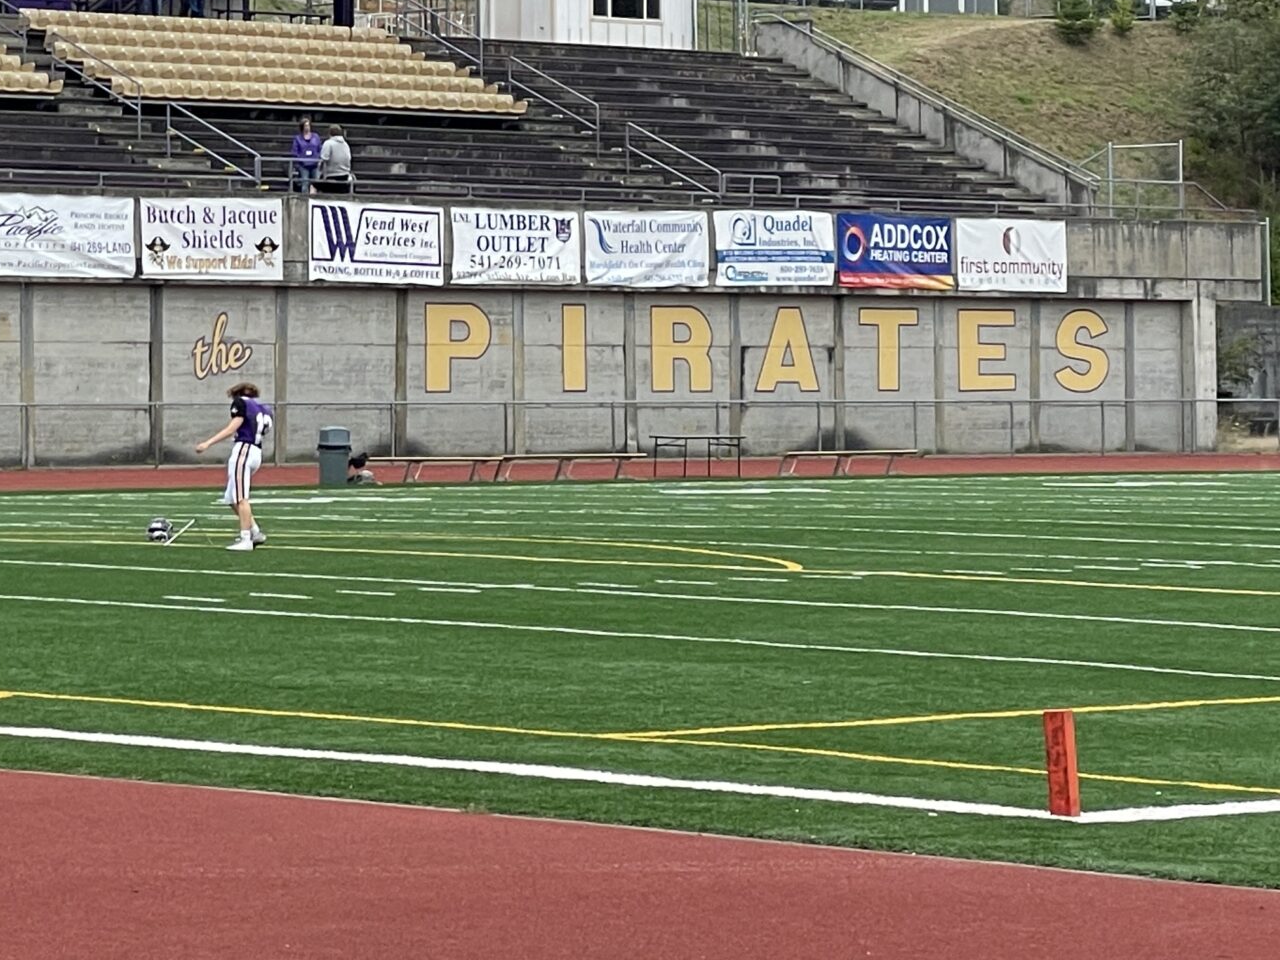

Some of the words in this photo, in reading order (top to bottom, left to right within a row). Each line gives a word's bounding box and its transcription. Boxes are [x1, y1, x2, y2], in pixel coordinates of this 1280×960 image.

[146, 204, 196, 224] Butch
[202, 206, 215, 224] &
[219, 205, 278, 229] Jacque
[364, 216, 396, 232] Vend
[400, 217, 430, 233] West
[475, 213, 551, 231] LUMBER
[763, 214, 813, 233] Quadel
[601, 219, 647, 233] Waterfall
[648, 220, 704, 236] Community
[181, 229, 244, 249] Shields
[363, 231, 417, 248] Services
[476, 235, 549, 253] OUTLET
[758, 236, 800, 249] Industries,
[802, 238, 818, 248] Inc.
[870, 223, 949, 251] ADDCOX
[87, 241, 132, 255] 269-LAND
[620, 240, 653, 254] Health
[655, 241, 687, 254] Center
[166, 254, 181, 269] We
[185, 254, 228, 274] Support
[230, 255, 257, 270] Kids!
[469, 254, 561, 270] 541-269-7071
[870, 249, 910, 262] HEATING
[911, 251, 949, 264] CENTER
[353, 267, 383, 277] BOTTLE
[409, 270, 441, 280] COFFEE
[960, 256, 989, 274] first
[992, 257, 1064, 280] community
[192, 311, 253, 381] the
[424, 301, 1110, 394] PIRATES
